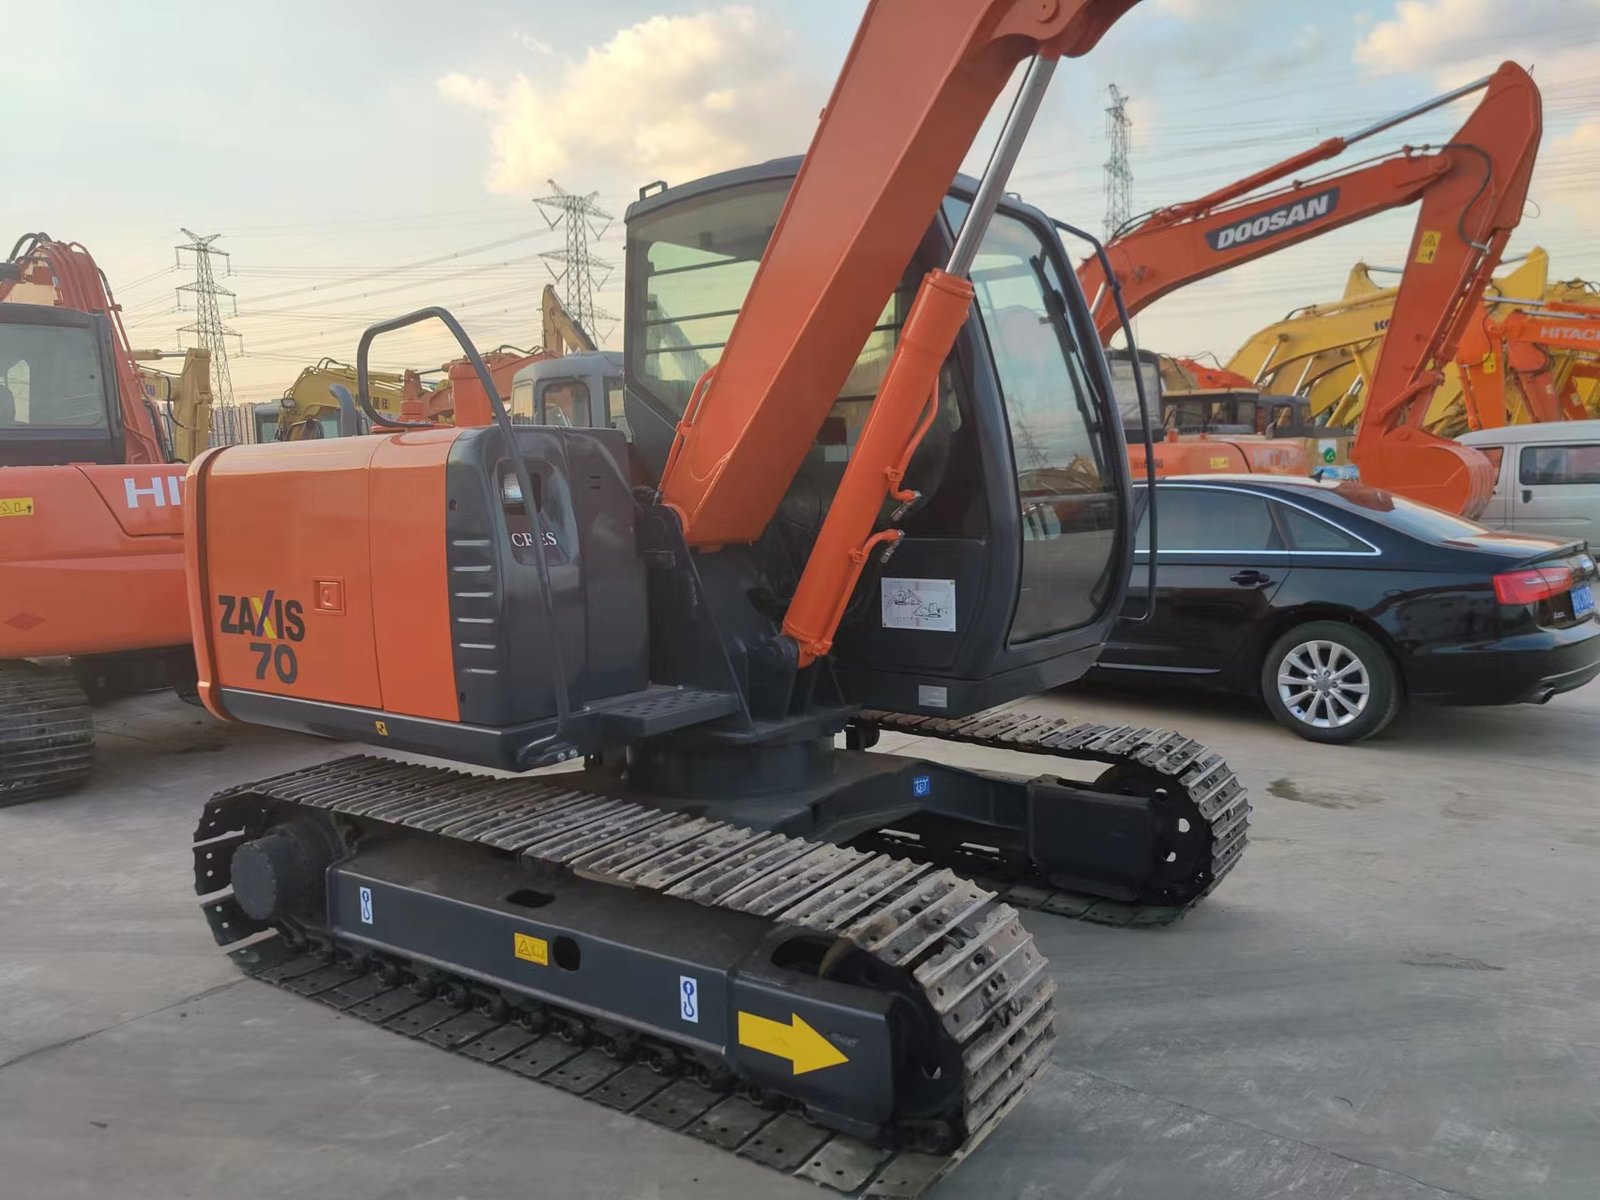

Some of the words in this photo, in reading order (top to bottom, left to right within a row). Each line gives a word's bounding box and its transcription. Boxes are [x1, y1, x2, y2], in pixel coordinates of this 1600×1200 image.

[1217, 194, 1329, 249] DOOSAN
[123, 475, 186, 509] HI
[218, 590, 306, 642] ZAXIS
[250, 642, 298, 685] 70
